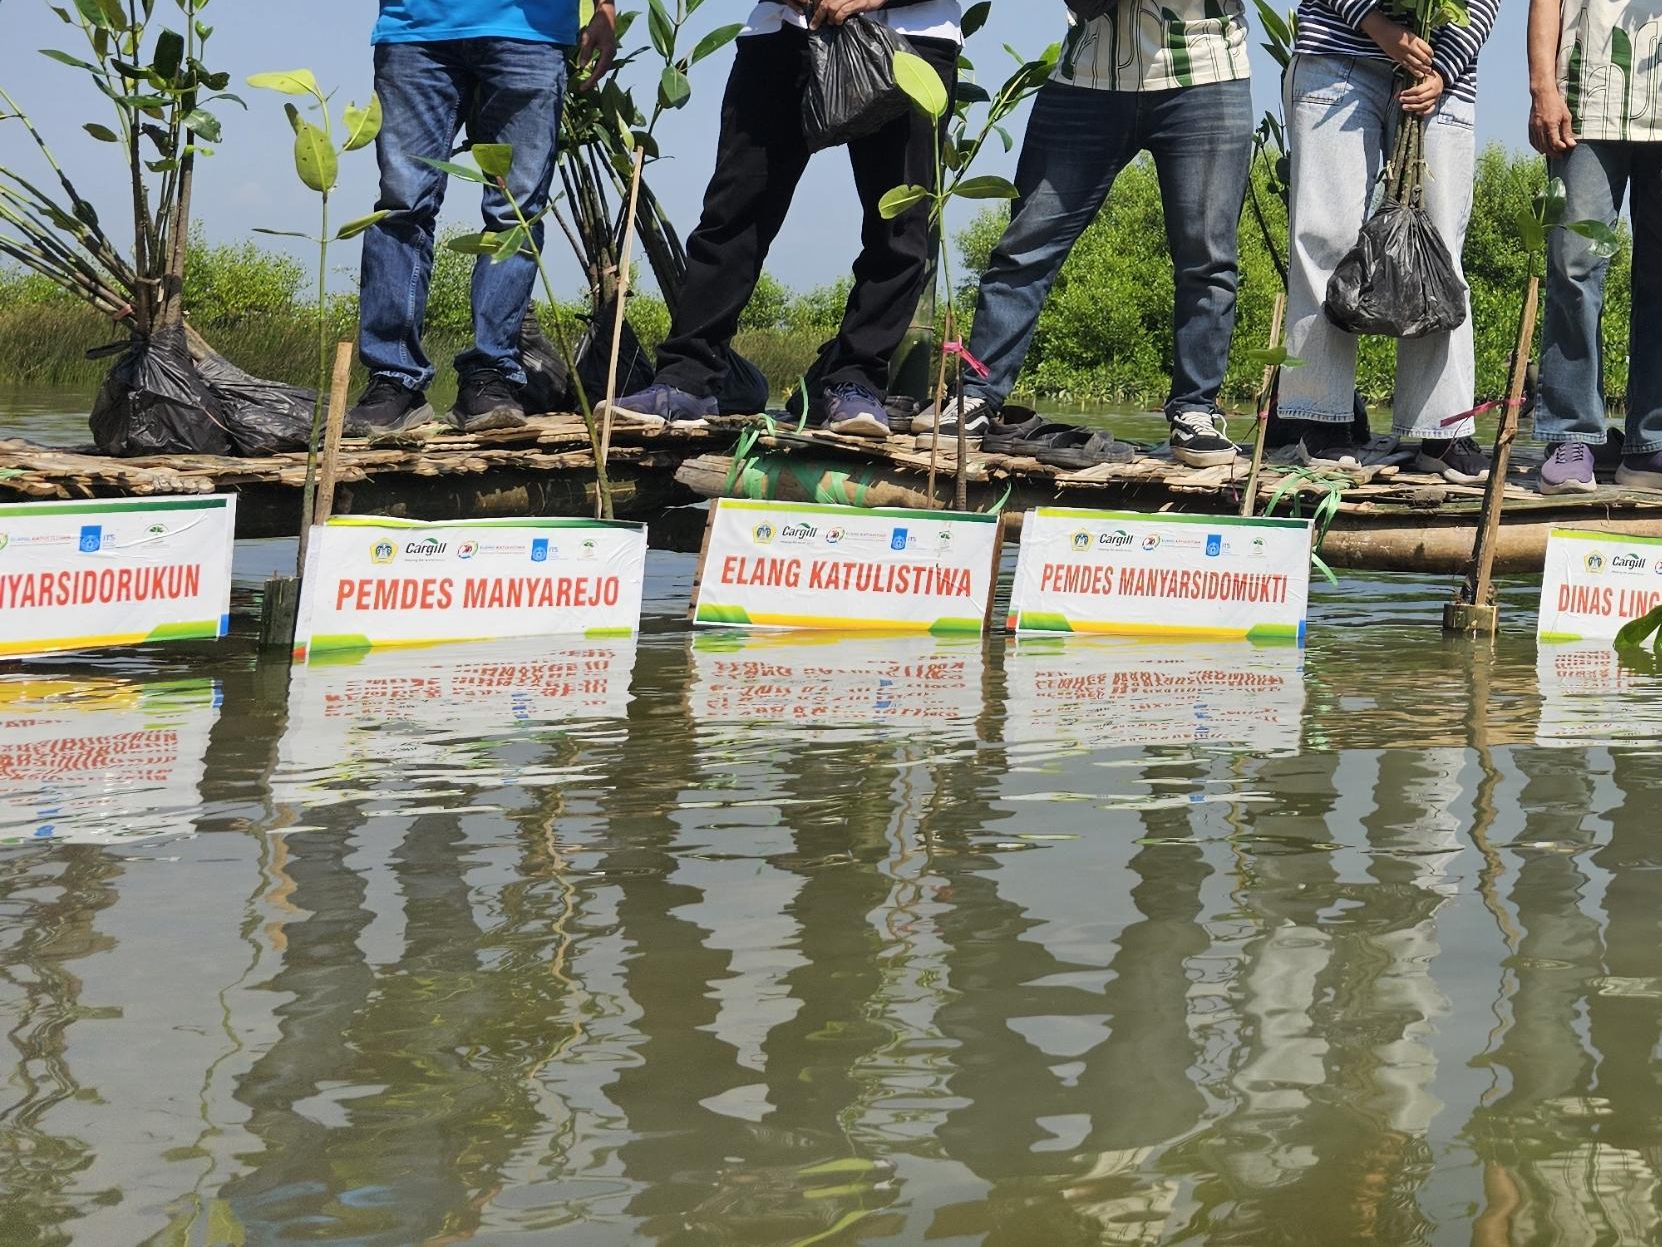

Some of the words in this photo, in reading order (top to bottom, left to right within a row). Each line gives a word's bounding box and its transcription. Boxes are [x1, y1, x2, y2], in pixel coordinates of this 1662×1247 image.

[781, 525, 818, 540] Cargill
[1099, 533, 1134, 546] Cargill
[405, 542, 447, 557] Cargill
[1612, 555, 1647, 570] Cargill
[720, 555, 801, 588] ELANG
[808, 560, 972, 597] KATULISTIWA
[1041, 563, 1112, 595] PEMDES
[1118, 568, 1287, 603] MANYARSIDOMUKTI
[335, 578, 454, 611] PEMDES
[462, 576, 620, 609] MANYAREJO
[1557, 584, 1612, 617] DINAS
